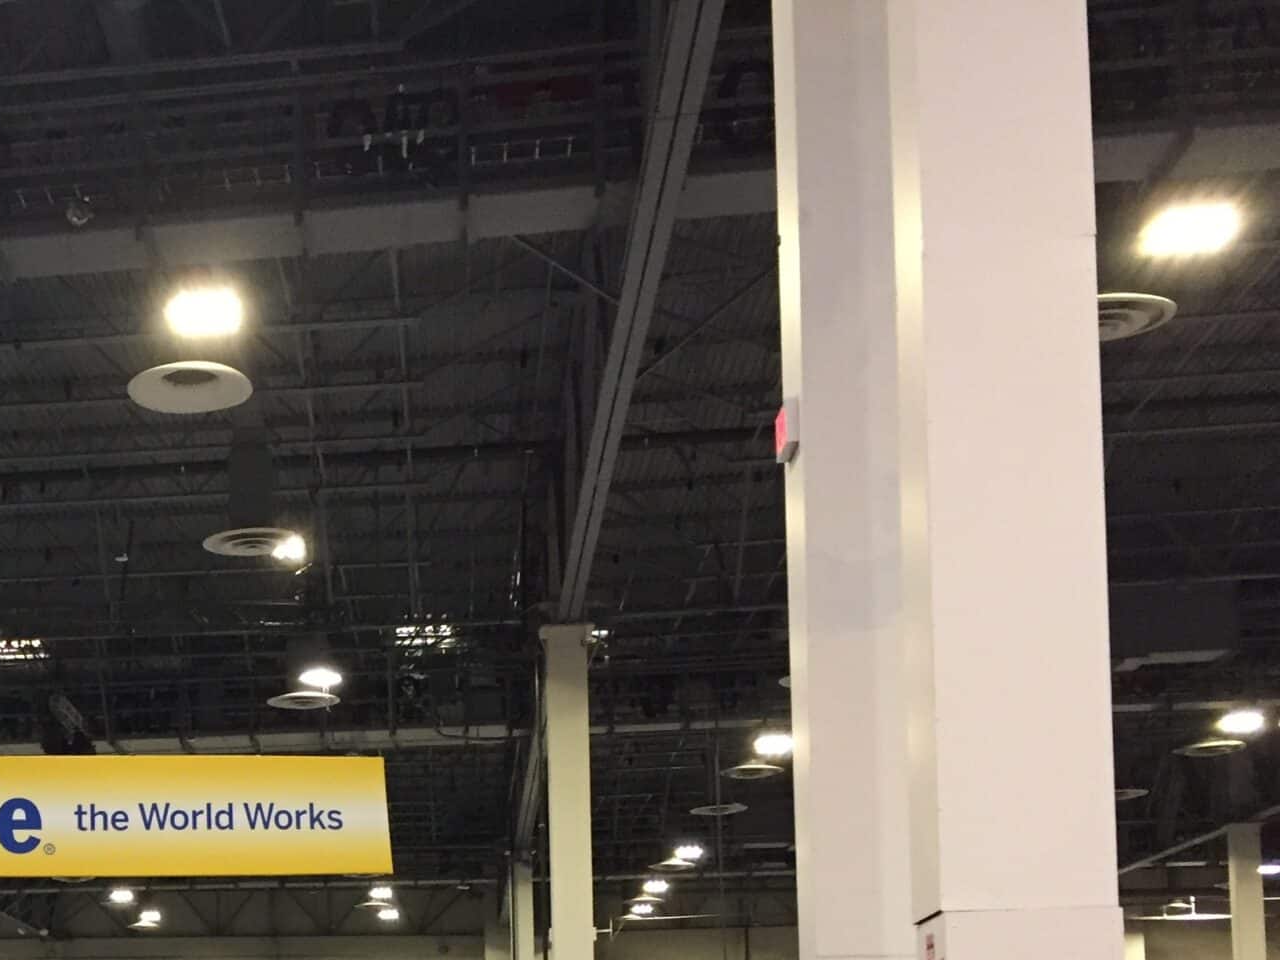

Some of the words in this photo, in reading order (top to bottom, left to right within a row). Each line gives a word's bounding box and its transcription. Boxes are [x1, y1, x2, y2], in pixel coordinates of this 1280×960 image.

[74, 803, 129, 831] the
[138, 802, 234, 831] World
[243, 802, 344, 831] Works
